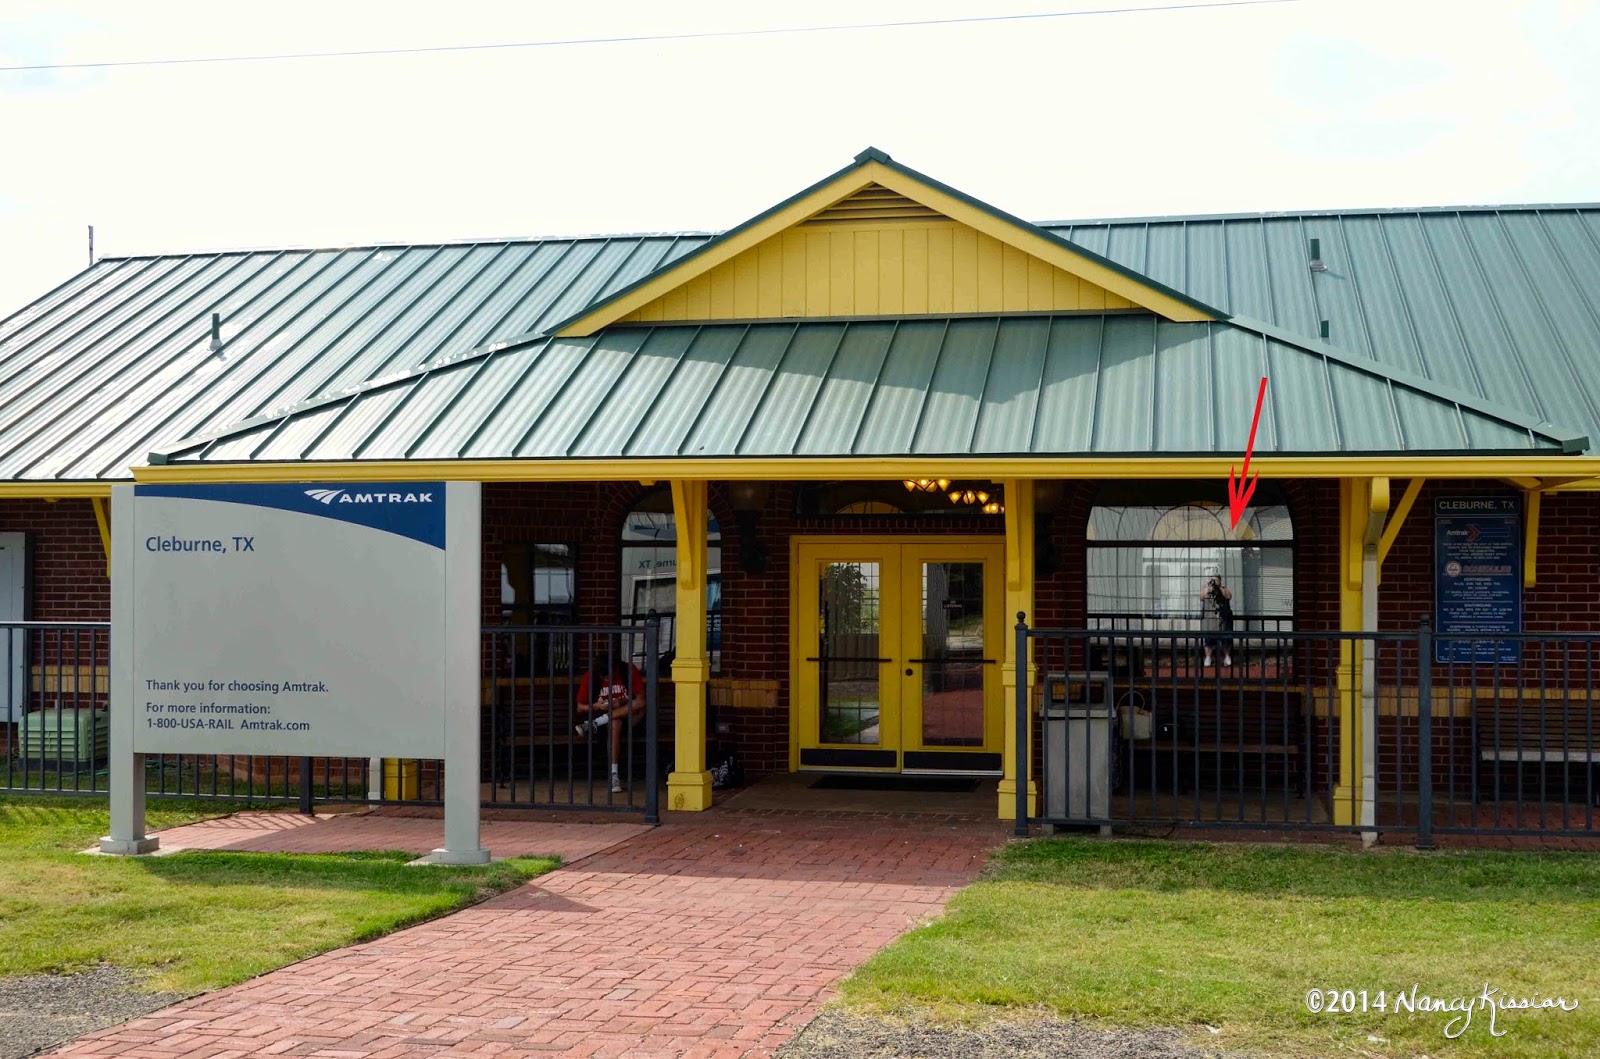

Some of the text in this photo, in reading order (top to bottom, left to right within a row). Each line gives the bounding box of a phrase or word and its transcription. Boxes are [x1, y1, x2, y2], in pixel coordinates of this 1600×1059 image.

[339, 492, 433, 503] AMTRAK
[1439, 500, 1515, 510] CLEBURNE, TX
[146, 536, 255, 553] Cleburne, TX
[146, 680, 329, 694] Thank you for choosing Amtrak.
[146, 702, 271, 714] For more information:
[147, 718, 310, 731] 1-800-USA-RAIL Amtrak.com
